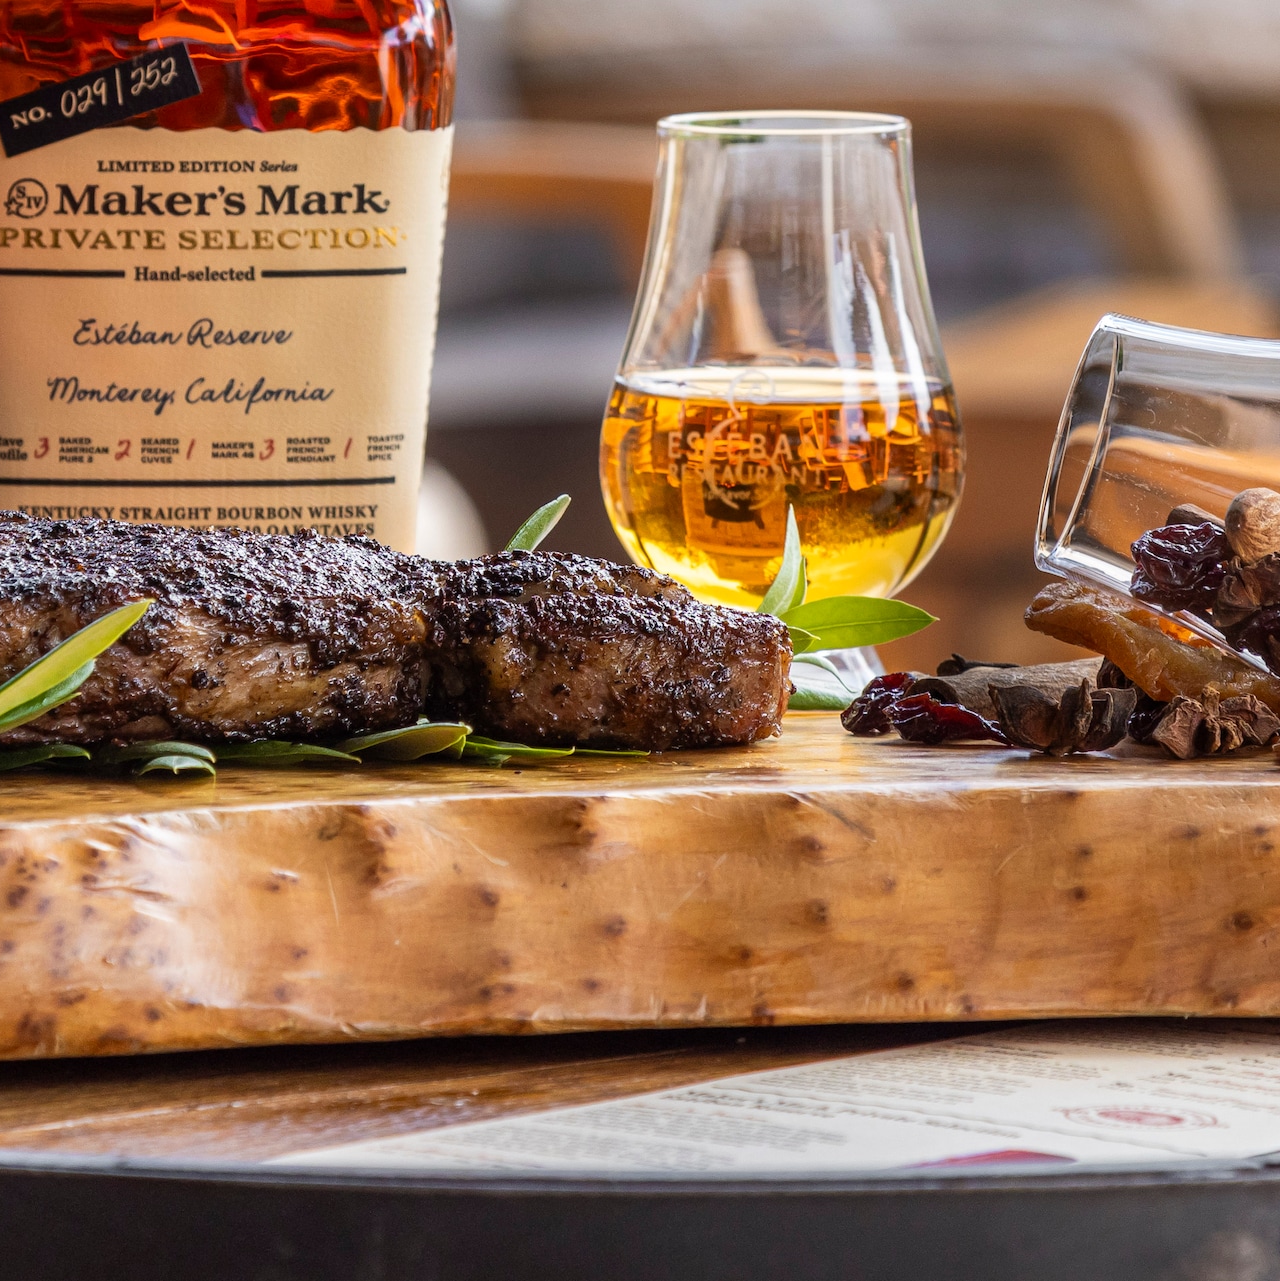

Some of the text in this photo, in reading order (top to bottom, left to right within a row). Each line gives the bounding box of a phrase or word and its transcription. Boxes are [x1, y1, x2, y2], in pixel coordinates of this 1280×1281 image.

[10, 105, 53, 129] NO.
[97, 160, 298, 173] LIMITED EDITION Series
[53, 183, 389, 217] Maker's Mark
[178, 225, 399, 251] SELECTION
[133, 265, 256, 282] Hand-selected
[72, 317, 293, 349] Estéban Reserve
[46, 375, 335, 416] Monterey, California
[33, 436, 51, 459] 3
[59, 446, 110, 455] AMERICAN
[114, 439, 132, 461] 2
[140, 446, 180, 455] FRENCH
[259, 438, 275, 461] 3
[119, 506, 211, 520] STRAIGHT
[217, 506, 303, 520] BOURBON
[308, 504, 378, 519] WHISKY
